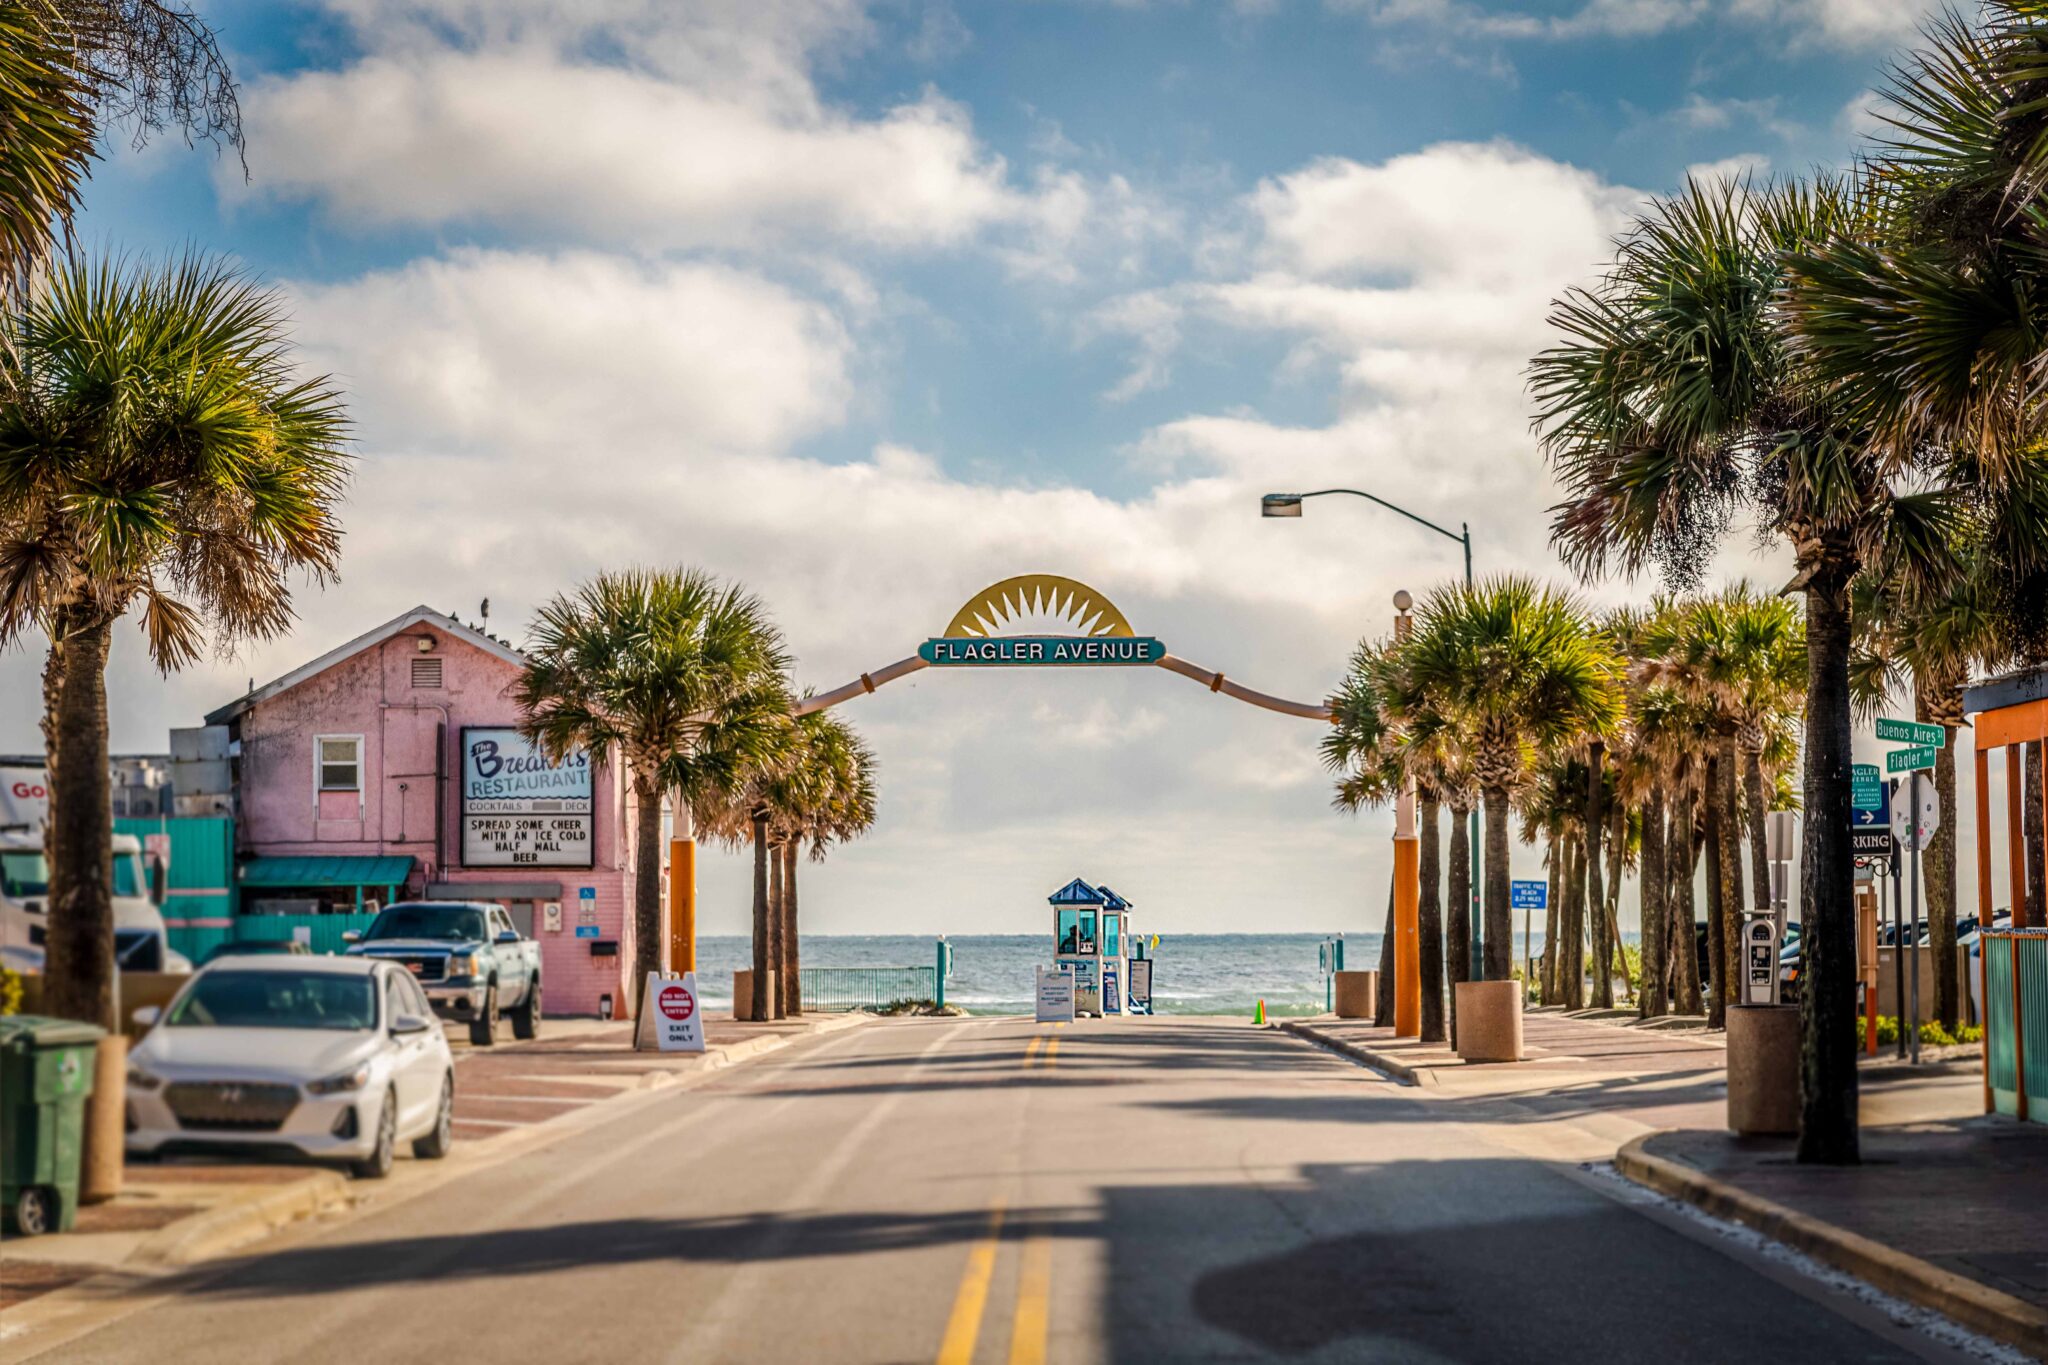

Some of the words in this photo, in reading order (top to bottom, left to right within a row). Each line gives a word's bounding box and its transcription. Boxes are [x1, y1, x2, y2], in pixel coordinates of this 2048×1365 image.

[933, 643, 1044, 660] FLAGLER
[1053, 642, 1150, 660] AVENUE
[1877, 721, 1910, 740] Buenos
[1913, 727, 1937, 743] Aires
[474, 742, 492, 753] The
[475, 740, 587, 779] Breakrs
[1890, 752, 1921, 770] Flagler
[1923, 749, 1933, 758] Ave
[471, 770, 588, 797] RESTAURANT
[469, 802, 523, 811] COCKTAILS
[565, 803, 588, 811] DECK
[471, 820, 512, 830] SPREAD
[516, 820, 544, 830] SOME
[551, 820, 582, 830] CHEER
[482, 831, 507, 841] WITH
[514, 831, 527, 840] AN
[535, 831, 552, 840] ICE
[559, 831, 586, 841] COLD
[495, 842, 521, 852] HALF
[535, 842, 561, 851] WALL
[513, 853, 538, 862] BEER
[669, 1034, 693, 1042] ONLY
